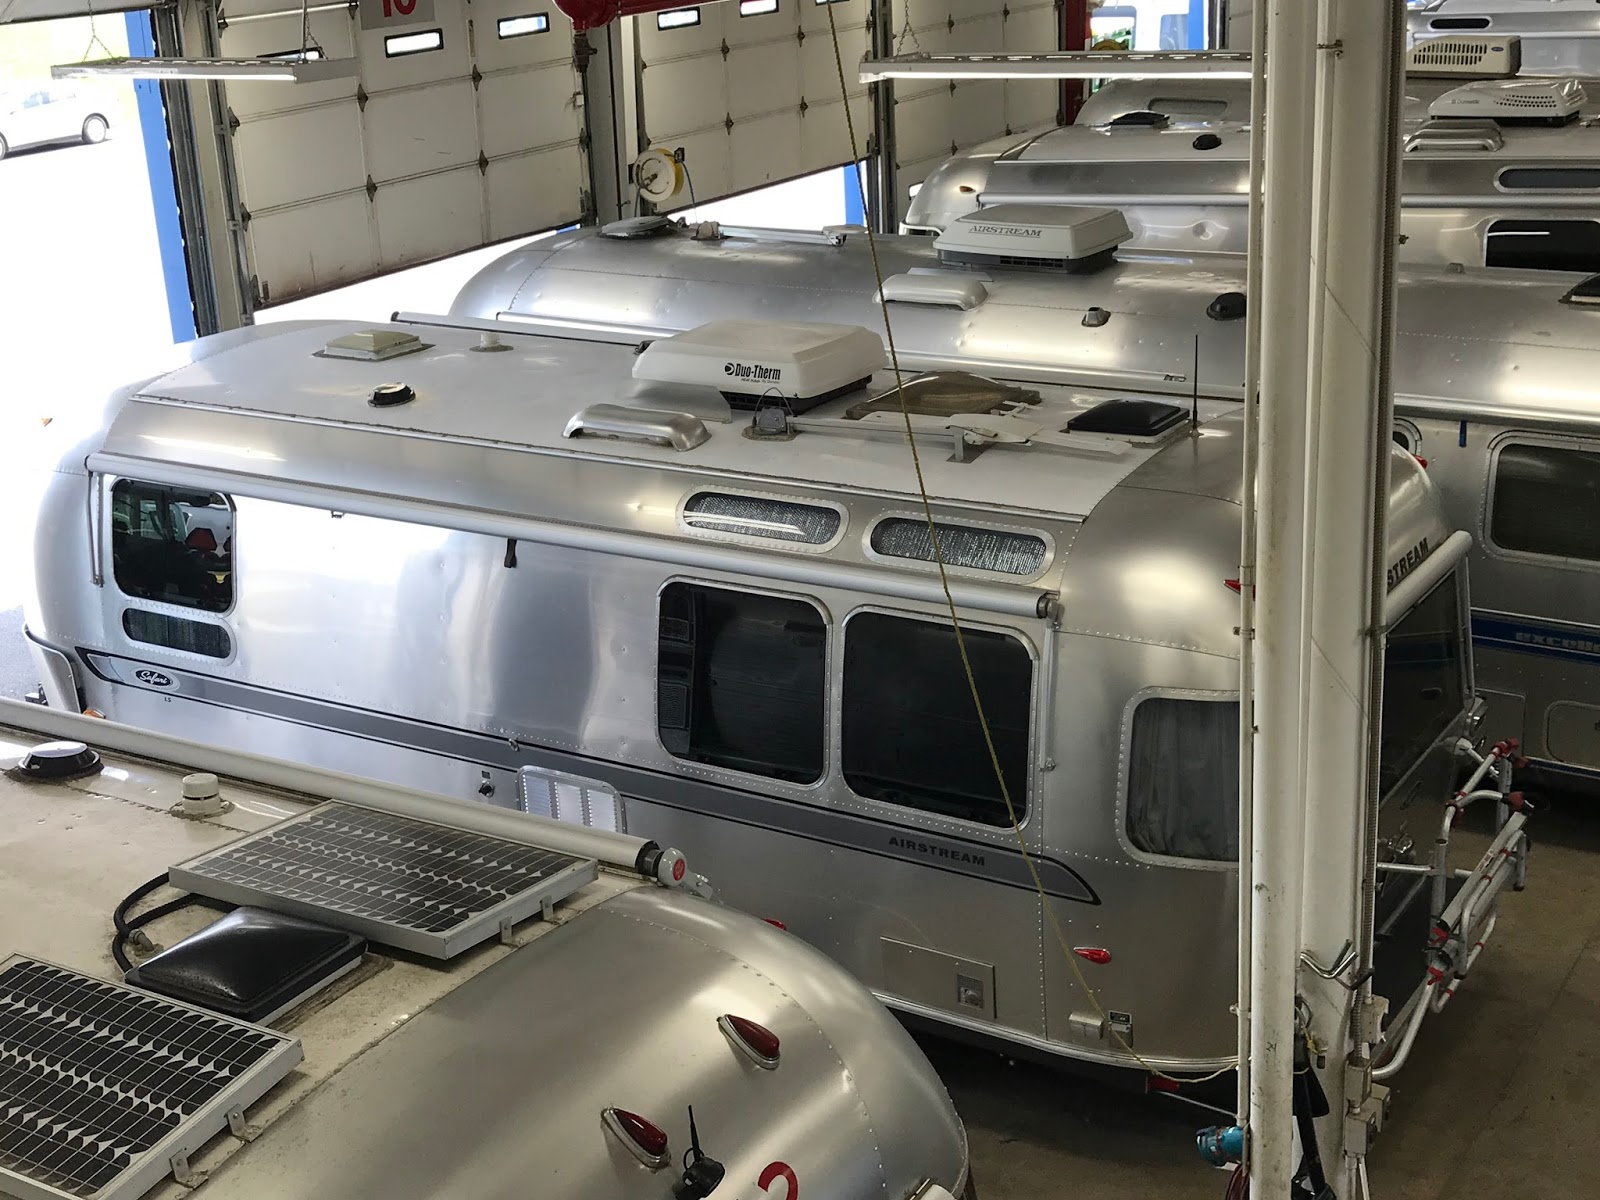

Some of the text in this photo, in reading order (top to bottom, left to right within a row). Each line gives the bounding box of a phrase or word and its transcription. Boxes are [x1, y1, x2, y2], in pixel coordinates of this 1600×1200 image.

[968, 225, 1042, 237] AIRSTREAM
[734, 363, 781, 380] Duo-Therm
[1387, 537, 1429, 588] STREAM
[888, 837, 985, 866] AIRSTREAM
